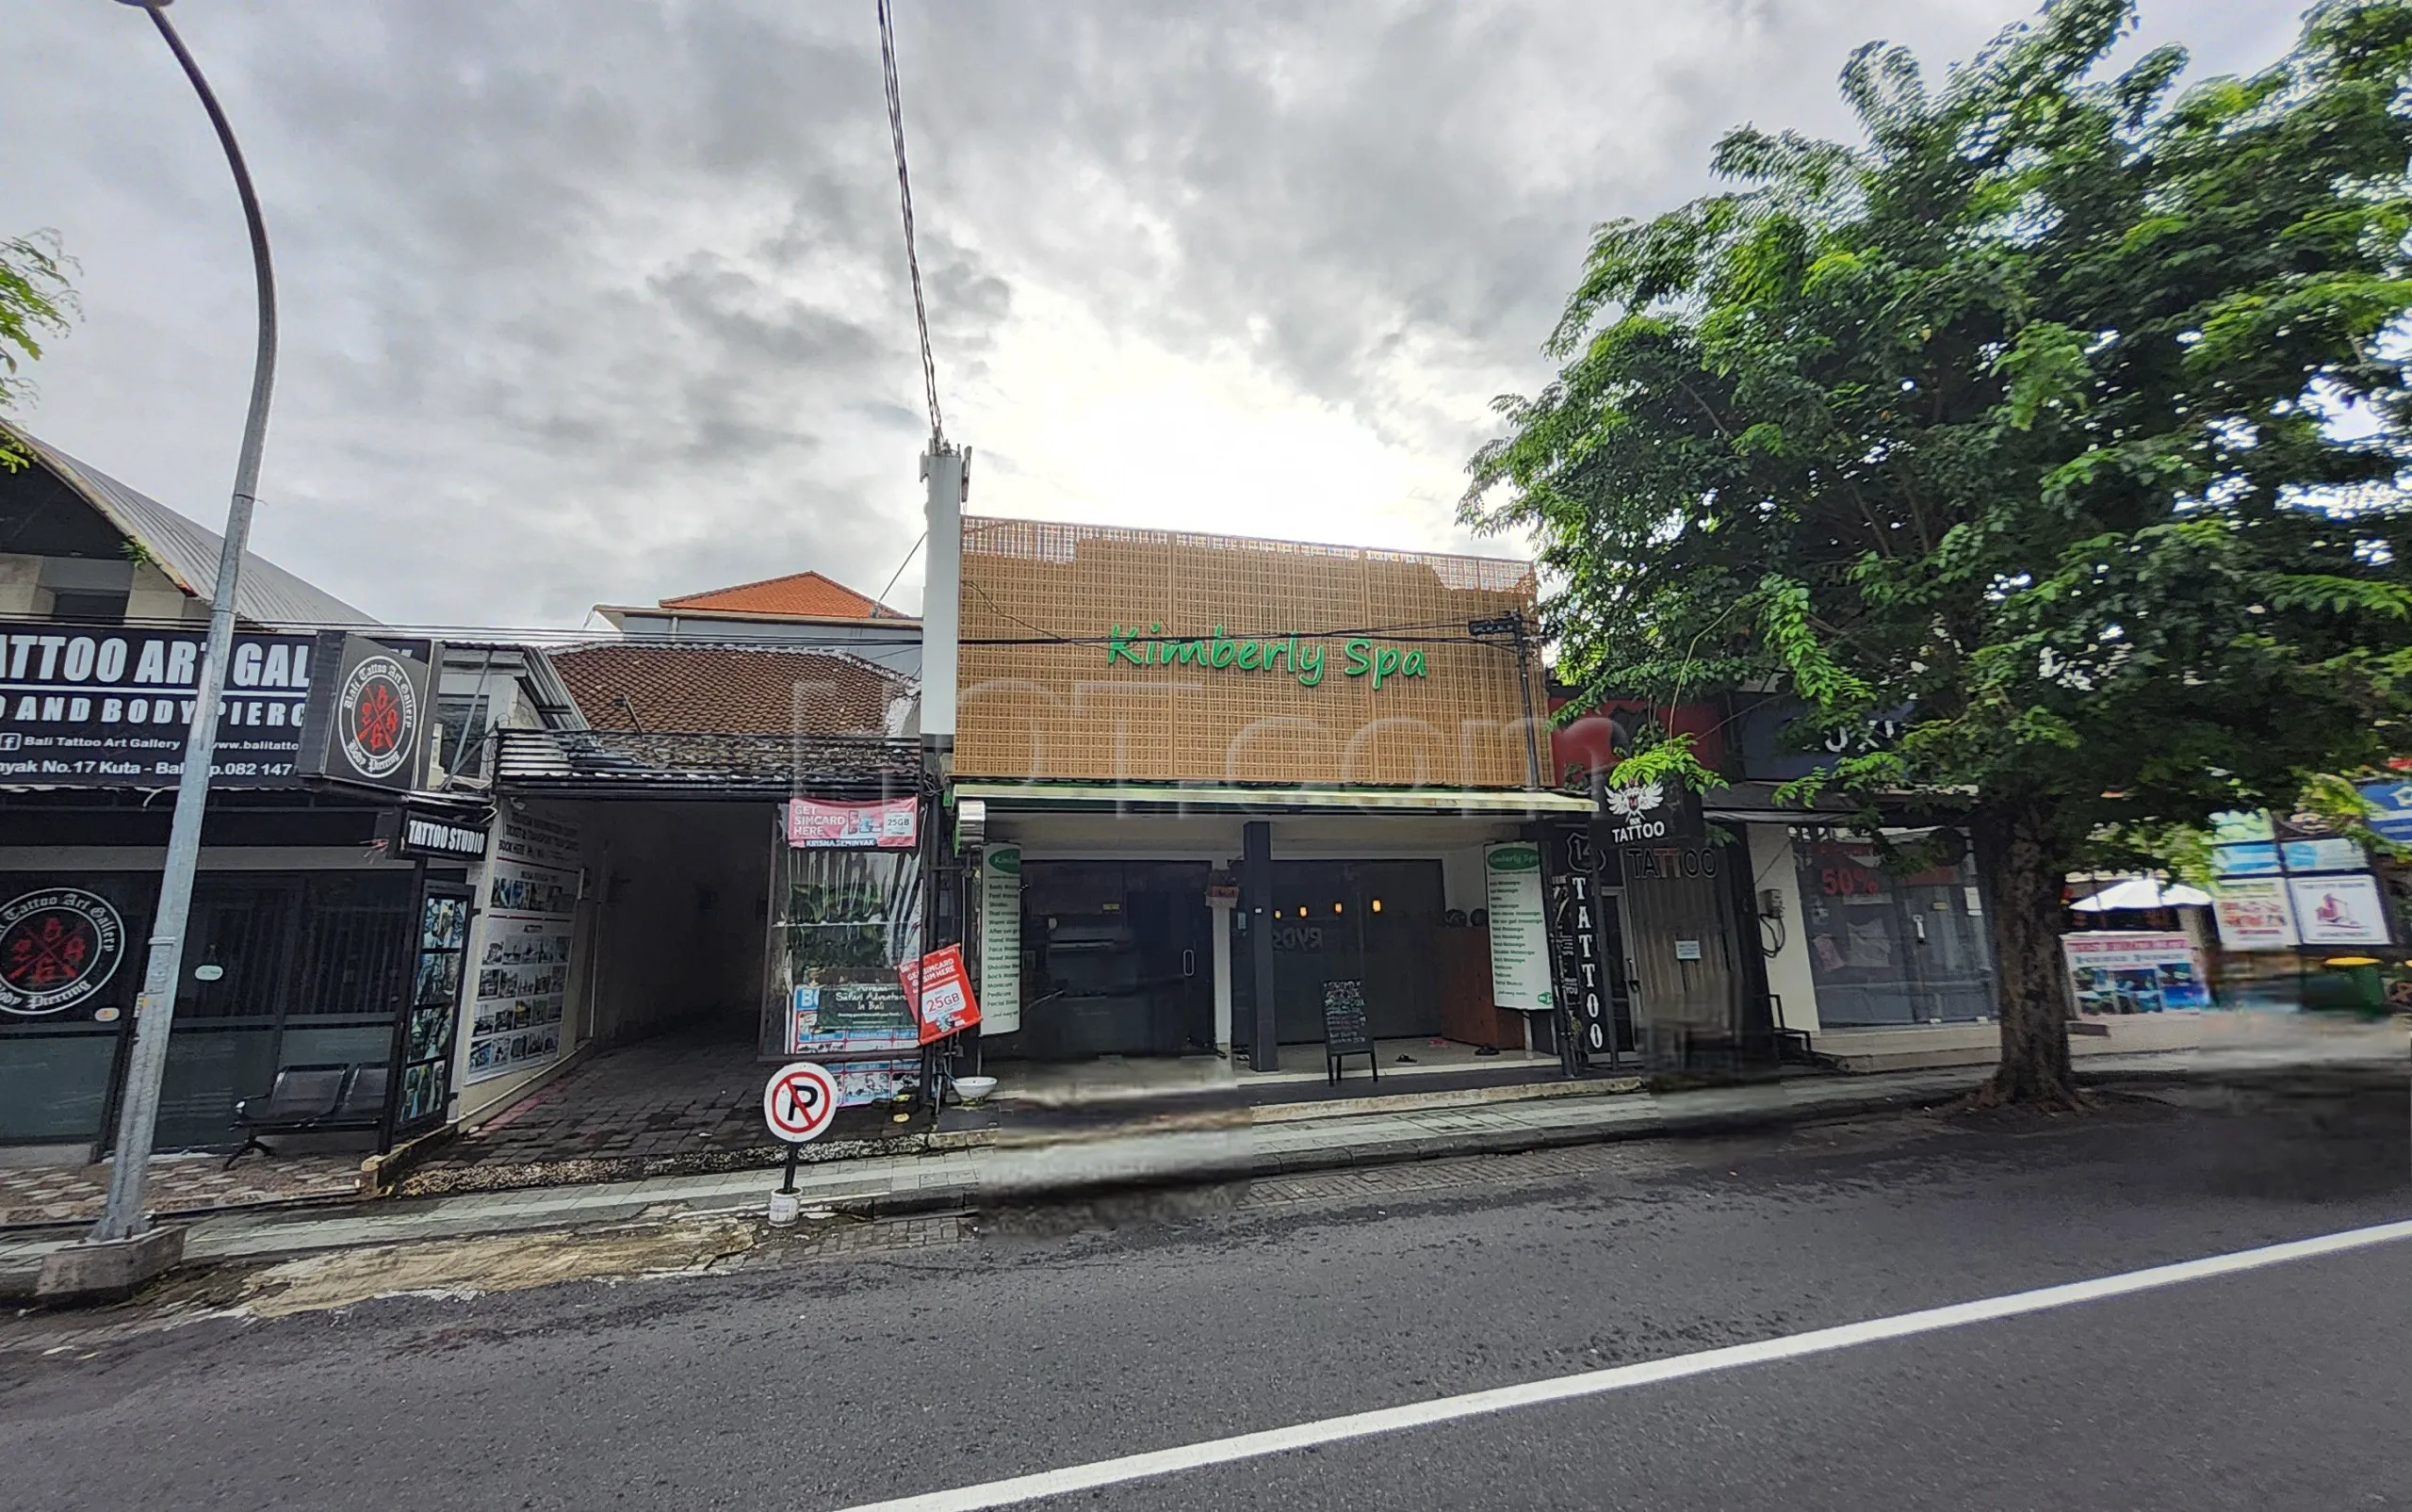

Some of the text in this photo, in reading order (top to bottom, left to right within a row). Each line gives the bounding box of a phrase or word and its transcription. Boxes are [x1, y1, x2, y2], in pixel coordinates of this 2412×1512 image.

[0, 635, 127, 683] TTOO
[133, 640, 209, 685] AR
[1108, 623, 1427, 690] Kimberly Spa
[358, 663, 387, 681] Tattoo
[387, 665, 403, 685] Art
[14, 696, 91, 723] AND
[101, 698, 197, 724] BODY
[24, 736, 54, 746] Bali
[57, 737, 102, 747] Tattoo
[104, 738, 127, 747] Art
[130, 739, 181, 750] Gallery
[41, 759, 96, 773] No.17
[99, 761, 141, 773] Kuta
[155, 761, 186, 774] Bal
[208, 762, 257, 777] p.082
[794, 805, 817, 816] GET
[794, 816, 846, 826] SIMCARD
[408, 820, 448, 850] TATTOO
[448, 827, 485, 854] STUDIO
[794, 826, 824, 837] HERE
[1612, 821, 1665, 843] TATTOO
[1627, 848, 1717, 879] TATTOO
[1822, 867, 1880, 896] 50%
[3, 893, 118, 952] Tattoo Art Gallery
[1573, 877, 1604, 1049] TATTOO
[926, 992, 960, 1013] 25GB
